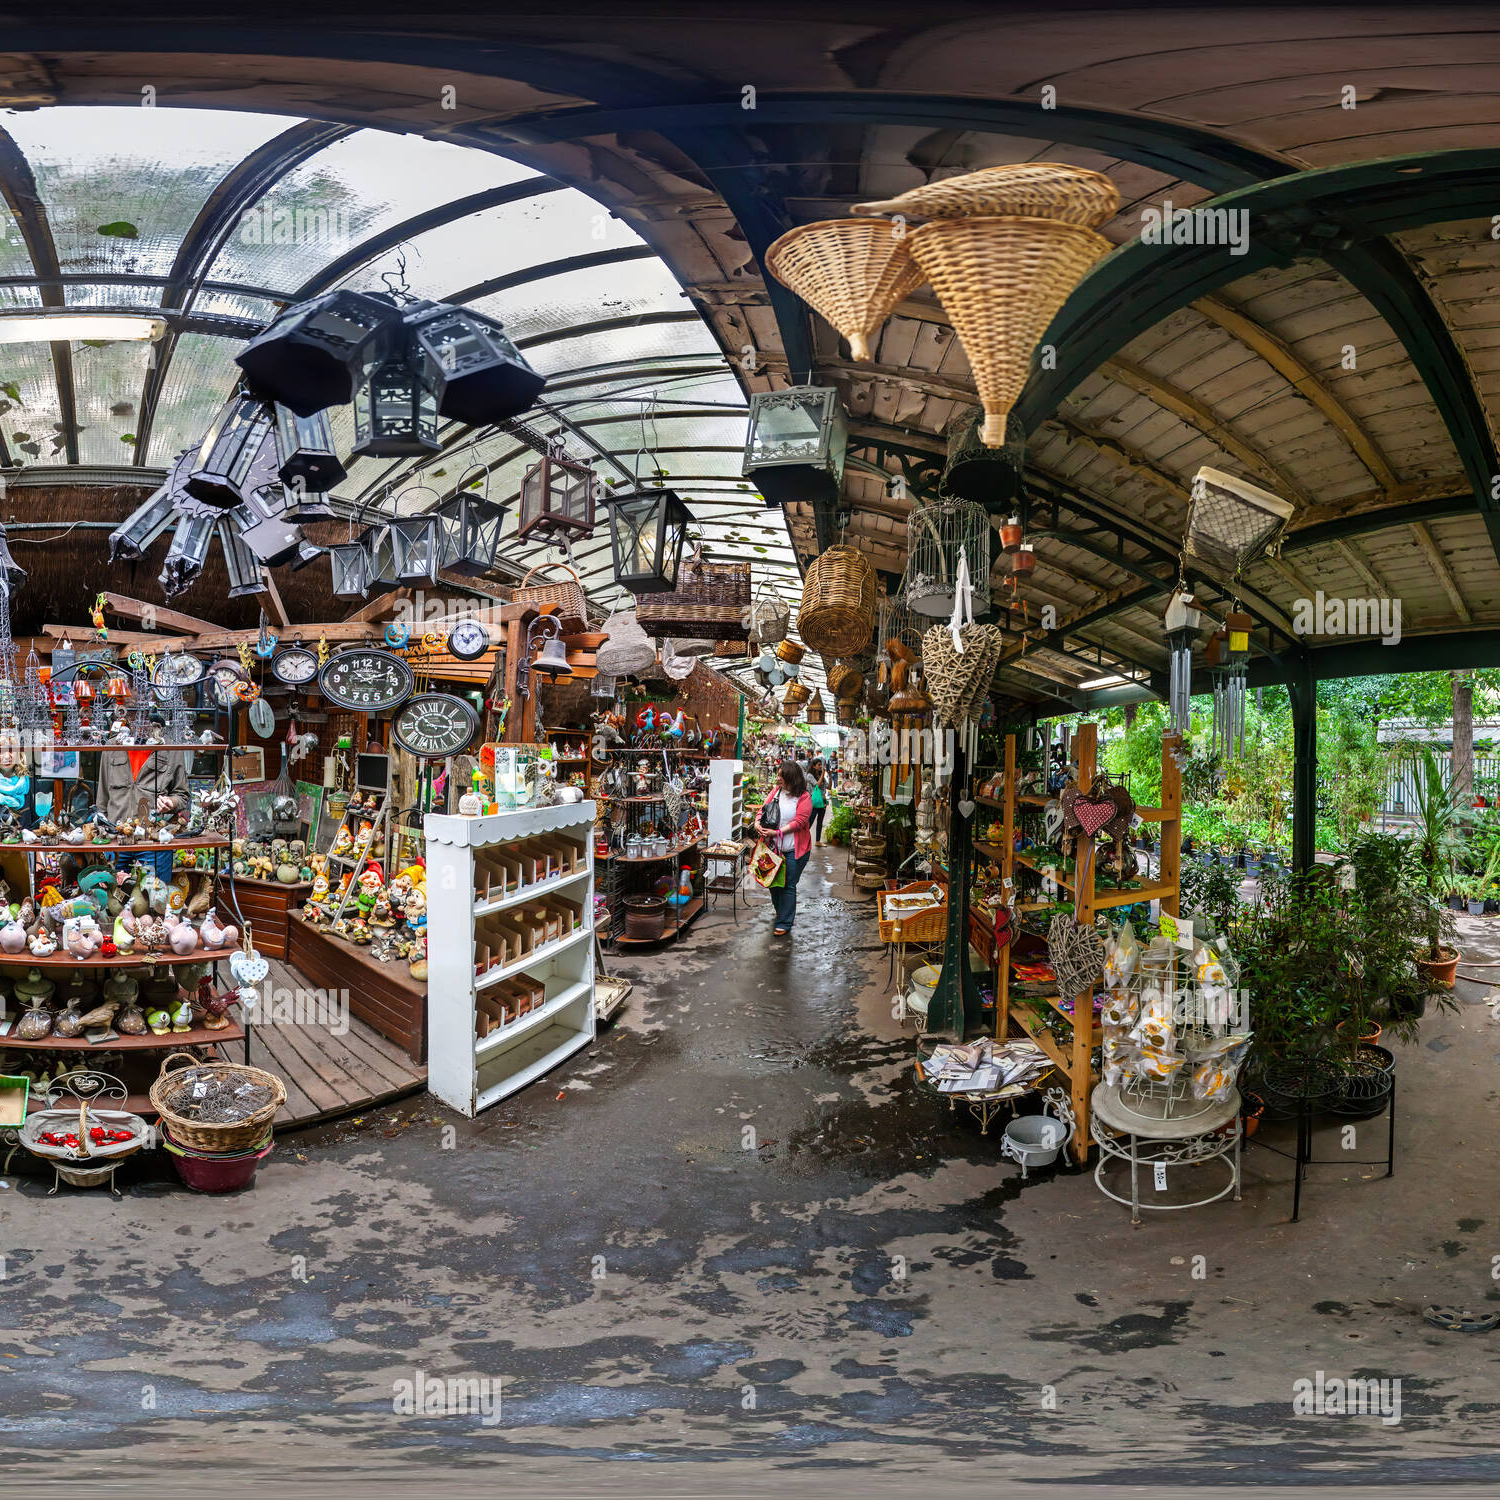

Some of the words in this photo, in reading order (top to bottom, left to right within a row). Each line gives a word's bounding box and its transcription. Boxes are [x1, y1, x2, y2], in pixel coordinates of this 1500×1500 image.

[352, 660, 360, 668] 11
[361, 659, 373, 667] 12
[376, 661, 382, 669] 1
[387, 666, 394, 674] 2
[333, 674, 340, 683] 9
[339, 686, 346, 695] 8
[386, 687, 394, 696] 4
[353, 692, 360, 701] 7
[362, 693, 369, 702] 6
[374, 692, 381, 701] 5
[428, 703, 438, 713] XII
